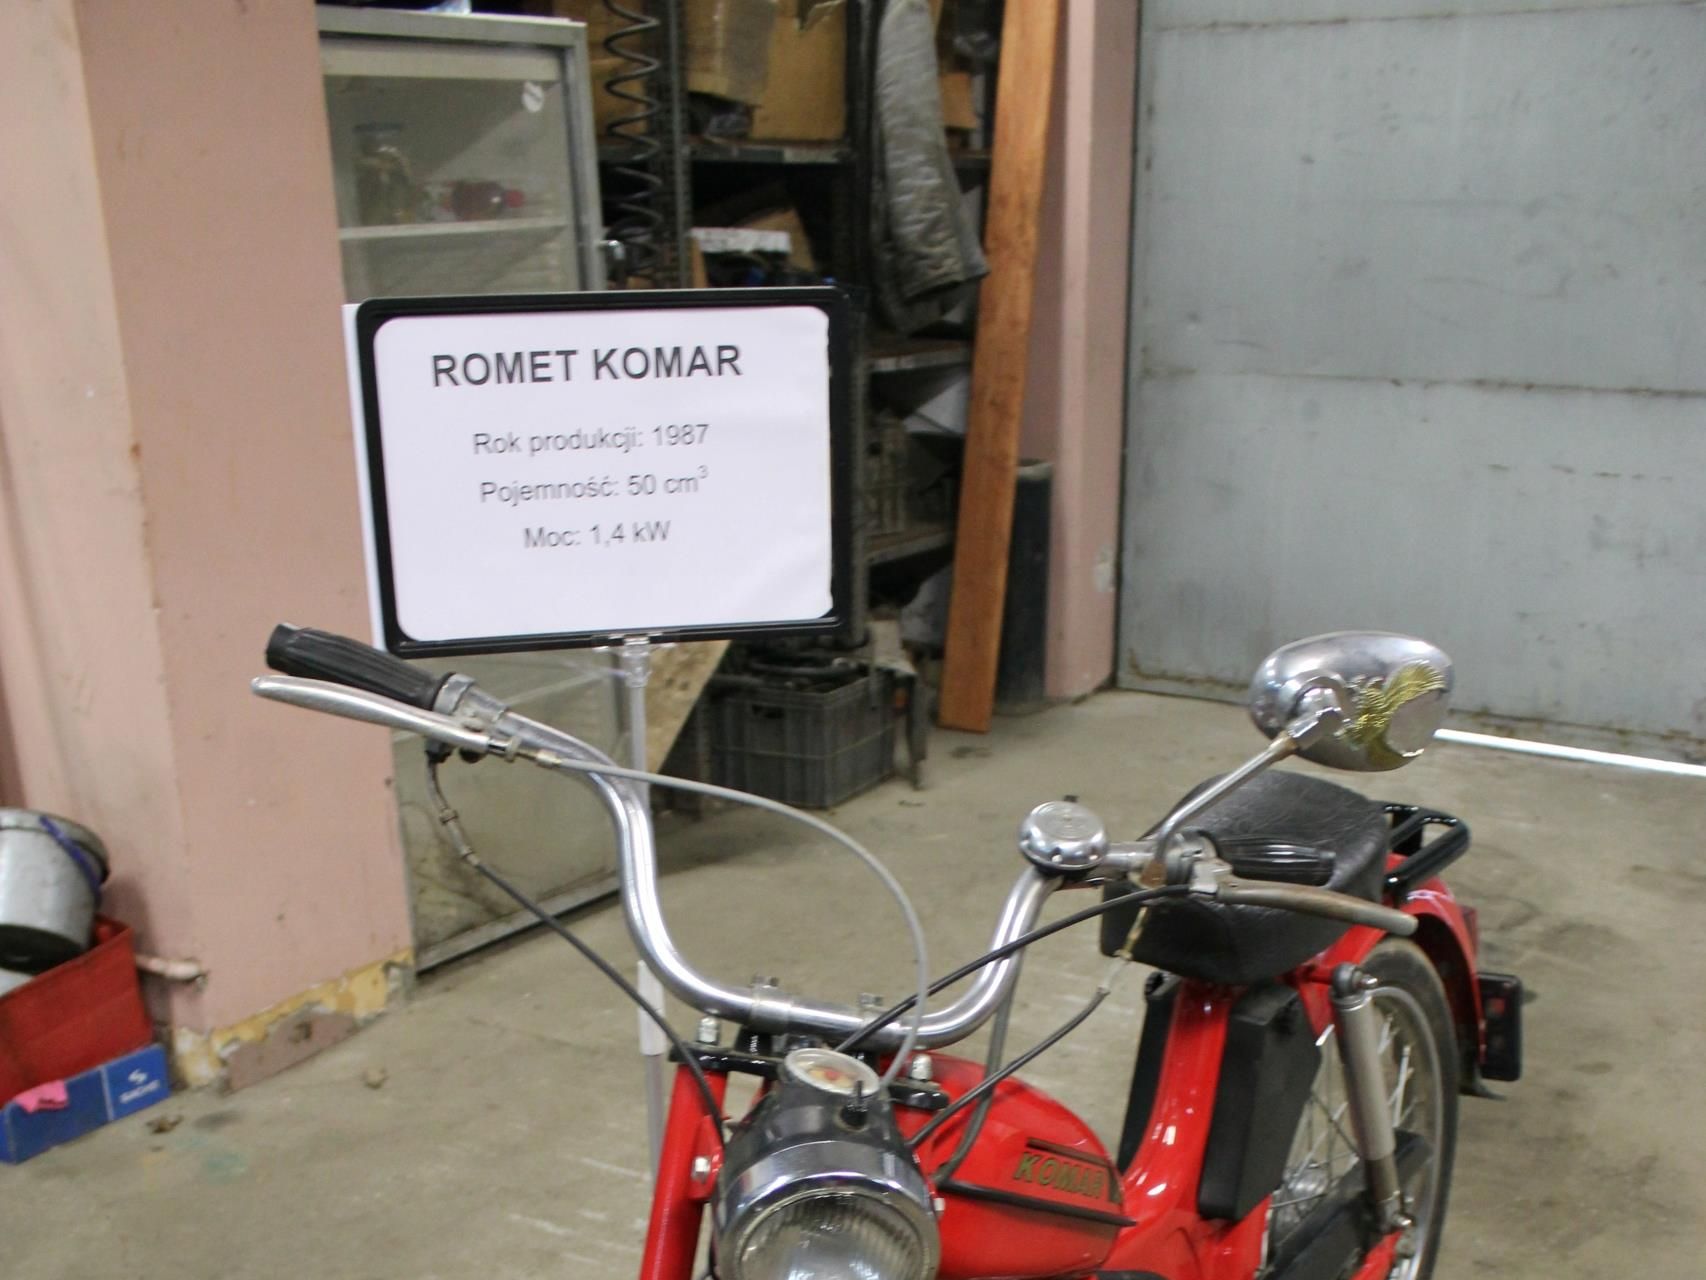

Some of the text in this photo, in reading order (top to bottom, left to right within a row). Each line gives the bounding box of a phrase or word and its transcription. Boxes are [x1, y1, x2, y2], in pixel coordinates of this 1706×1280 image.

[432, 344, 743, 387] ROMET KOMAR
[473, 423, 710, 456] Rok produkcji: 1987
[479, 475, 619, 507] Pojemność:
[627, 474, 657, 496] 50
[523, 519, 671, 549] Moc: 1,4 kW
